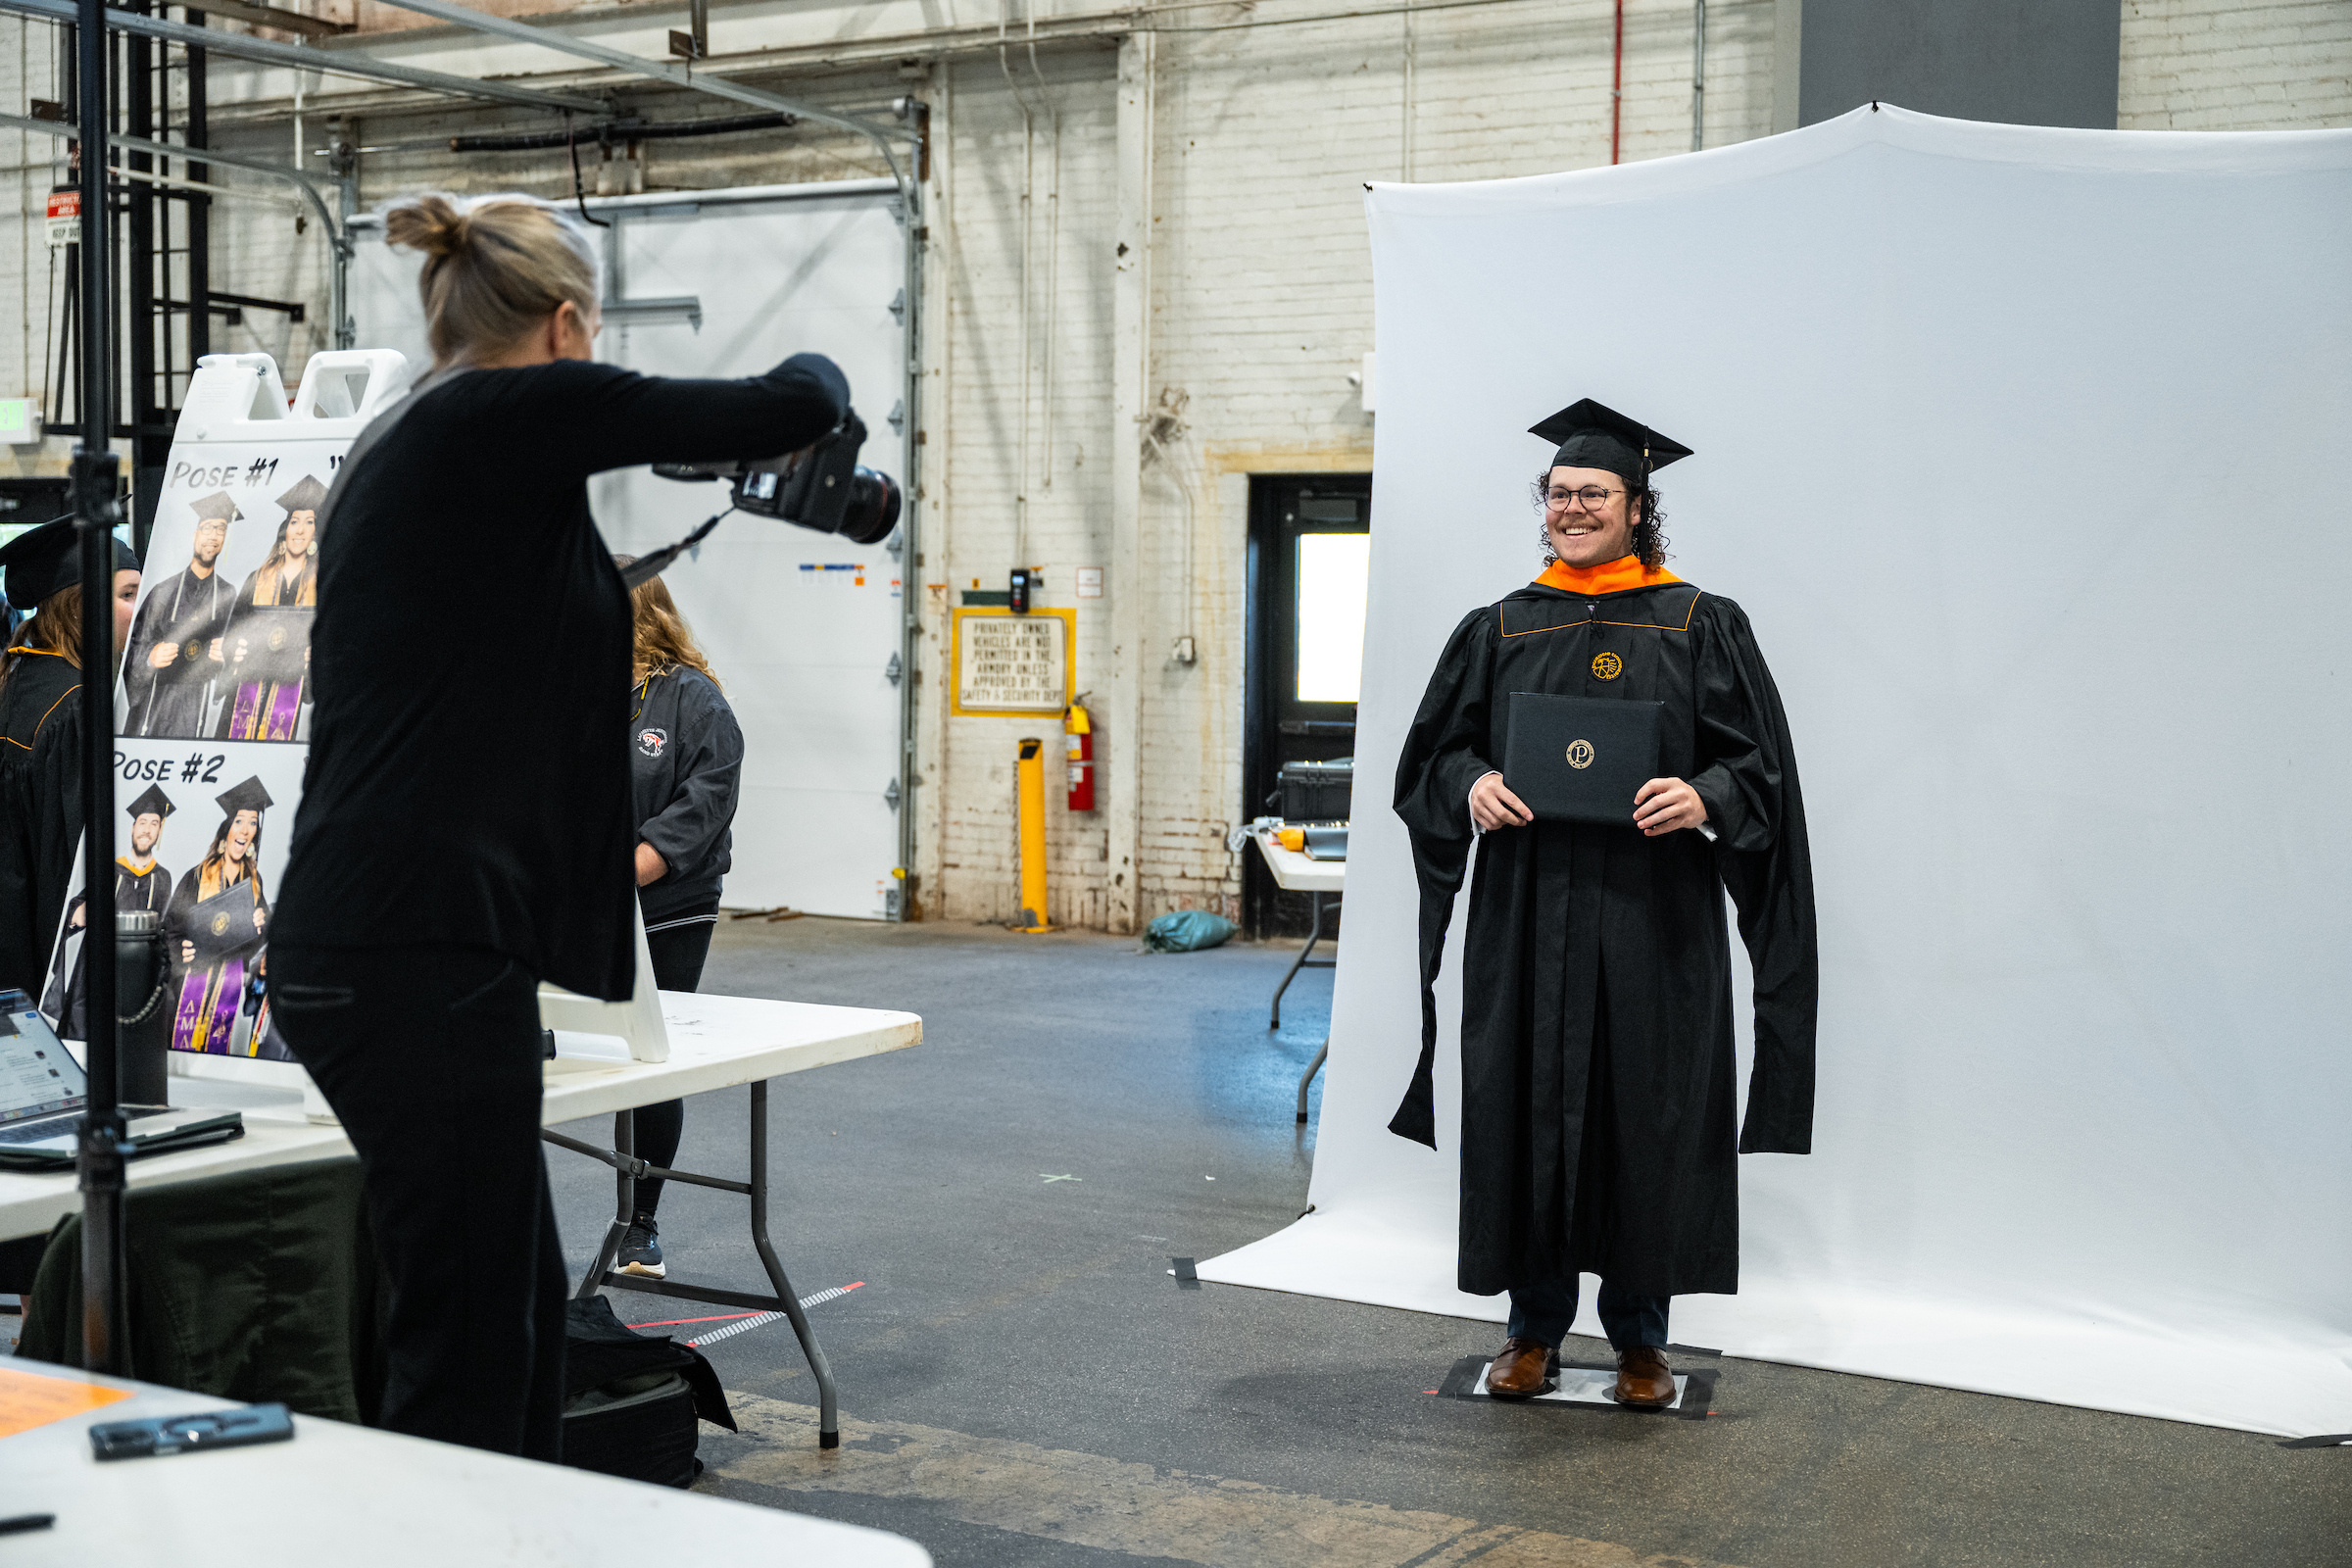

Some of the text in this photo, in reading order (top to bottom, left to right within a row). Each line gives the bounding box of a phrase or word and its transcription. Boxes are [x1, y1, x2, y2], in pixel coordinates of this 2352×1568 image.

[49, 195, 80, 207] RESTRICT
[170, 458, 278, 488] POSE #1
[974, 622, 1050, 634] PRIVATELY OWNED
[973, 636, 1051, 647] VEHICLES ARE NOT
[974, 650, 1050, 661] PERMITTED IN THE
[977, 663, 1049, 674] ARMORY UNLESS
[973, 676, 1050, 688] APPROVED BY THE
[962, 690, 991, 701] SAFETY
[1003, 690, 1040, 701] SECURITY
[1574, 746, 1588, 762] P
[114, 751, 225, 783] POSE #2
